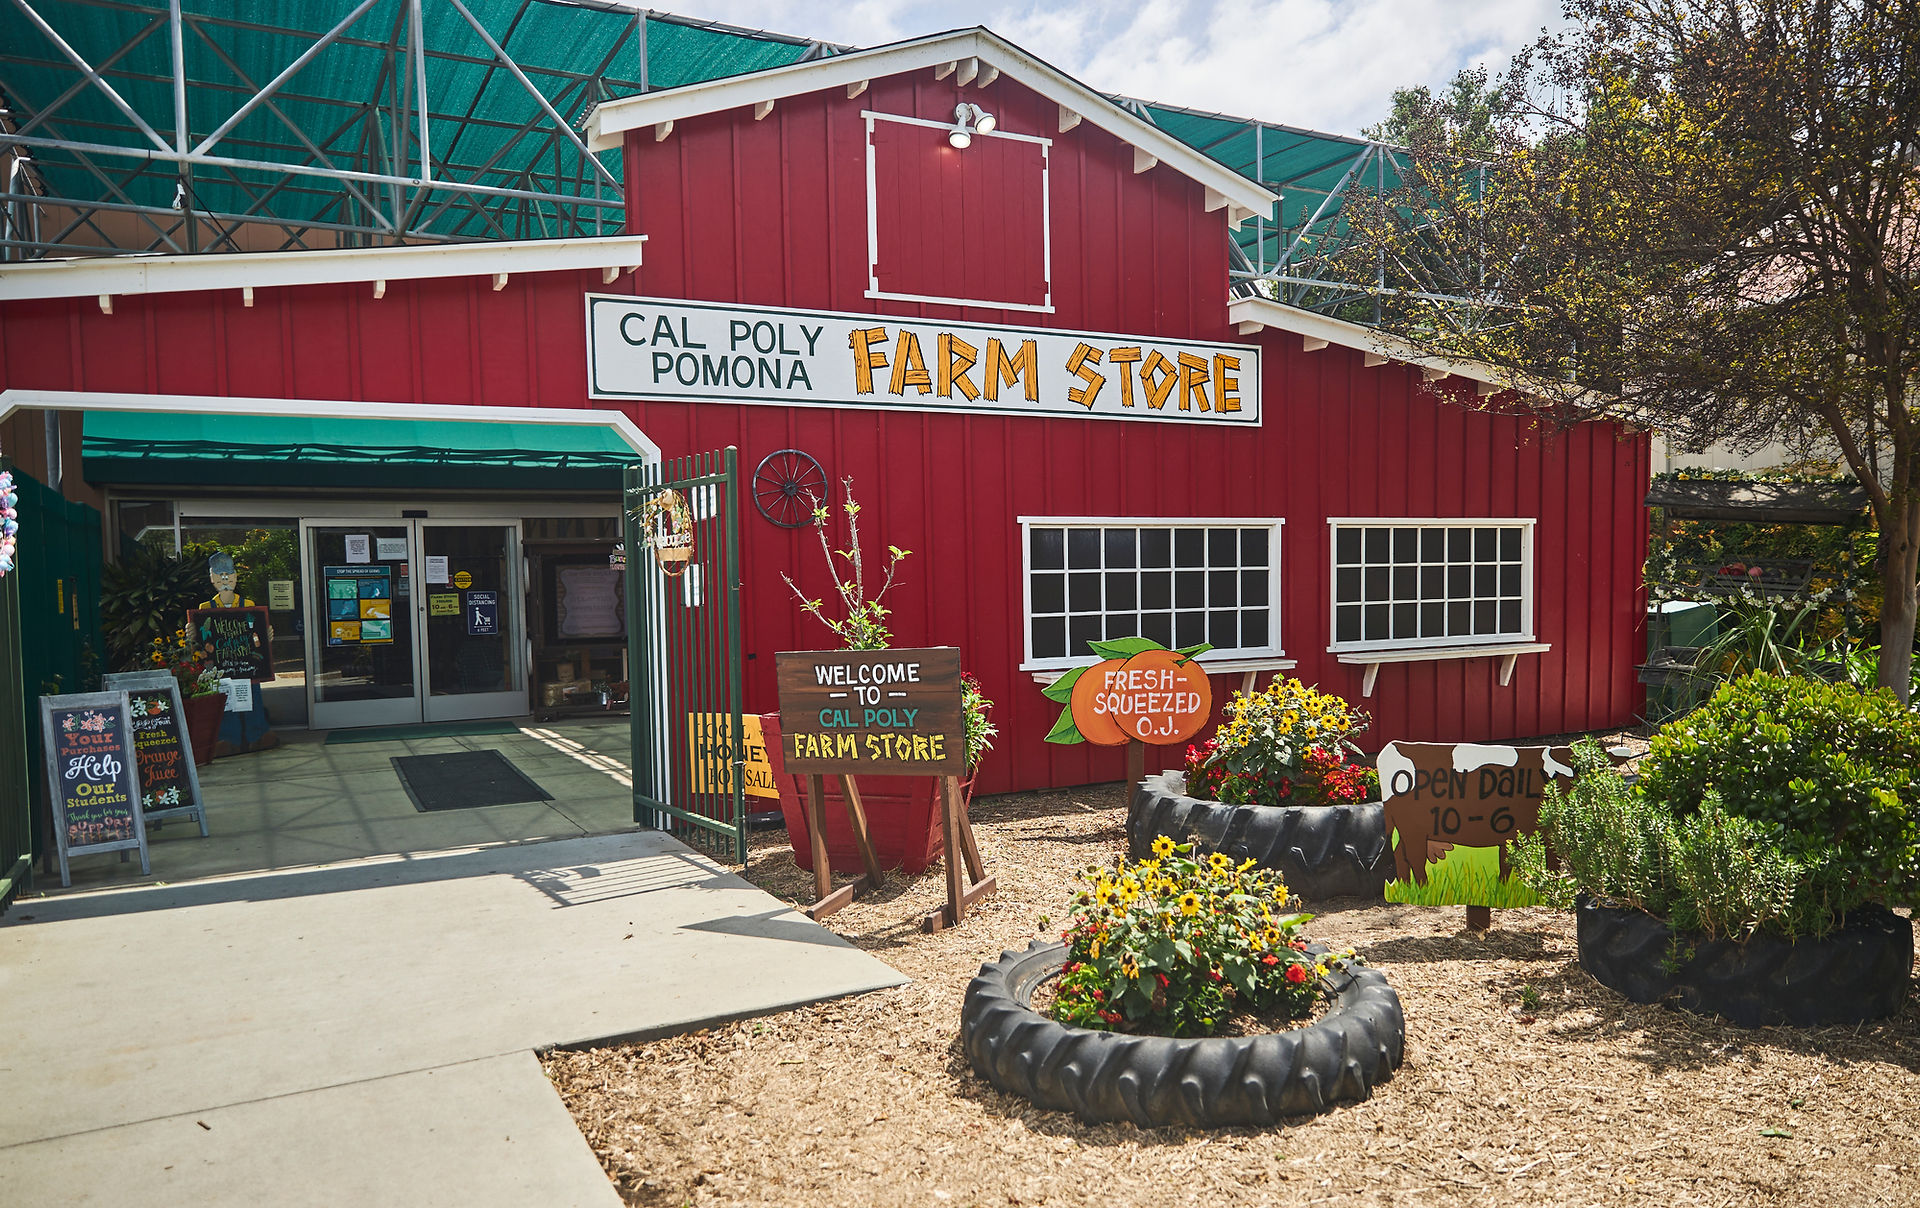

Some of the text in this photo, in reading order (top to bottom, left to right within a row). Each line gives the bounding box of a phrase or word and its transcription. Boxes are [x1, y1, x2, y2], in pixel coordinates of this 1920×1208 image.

[619, 312, 824, 357] CAL POLY
[651, 351, 813, 391] POMONA
[847, 325, 1243, 415] FARM STORE
[814, 662, 921, 686] WELCOME
[1104, 668, 1188, 690] FRESH-
[853, 685, 881, 706] TO
[1093, 691, 1201, 716] SQUEEZED
[818, 707, 919, 728] CAL POLY
[1136, 715, 1180, 737] O.J.
[64, 732, 114, 746] Your
[138, 730, 168, 739] Fresh
[60, 744, 121, 756] Purchases
[136, 749, 181, 767] Orange
[793, 732, 947, 762] FARM STORE
[64, 754, 122, 782] Help
[144, 764, 180, 787] Juice
[75, 782, 115, 796] Our
[66, 794, 127, 808] Students
[69, 816, 132, 835] SUPPORT
